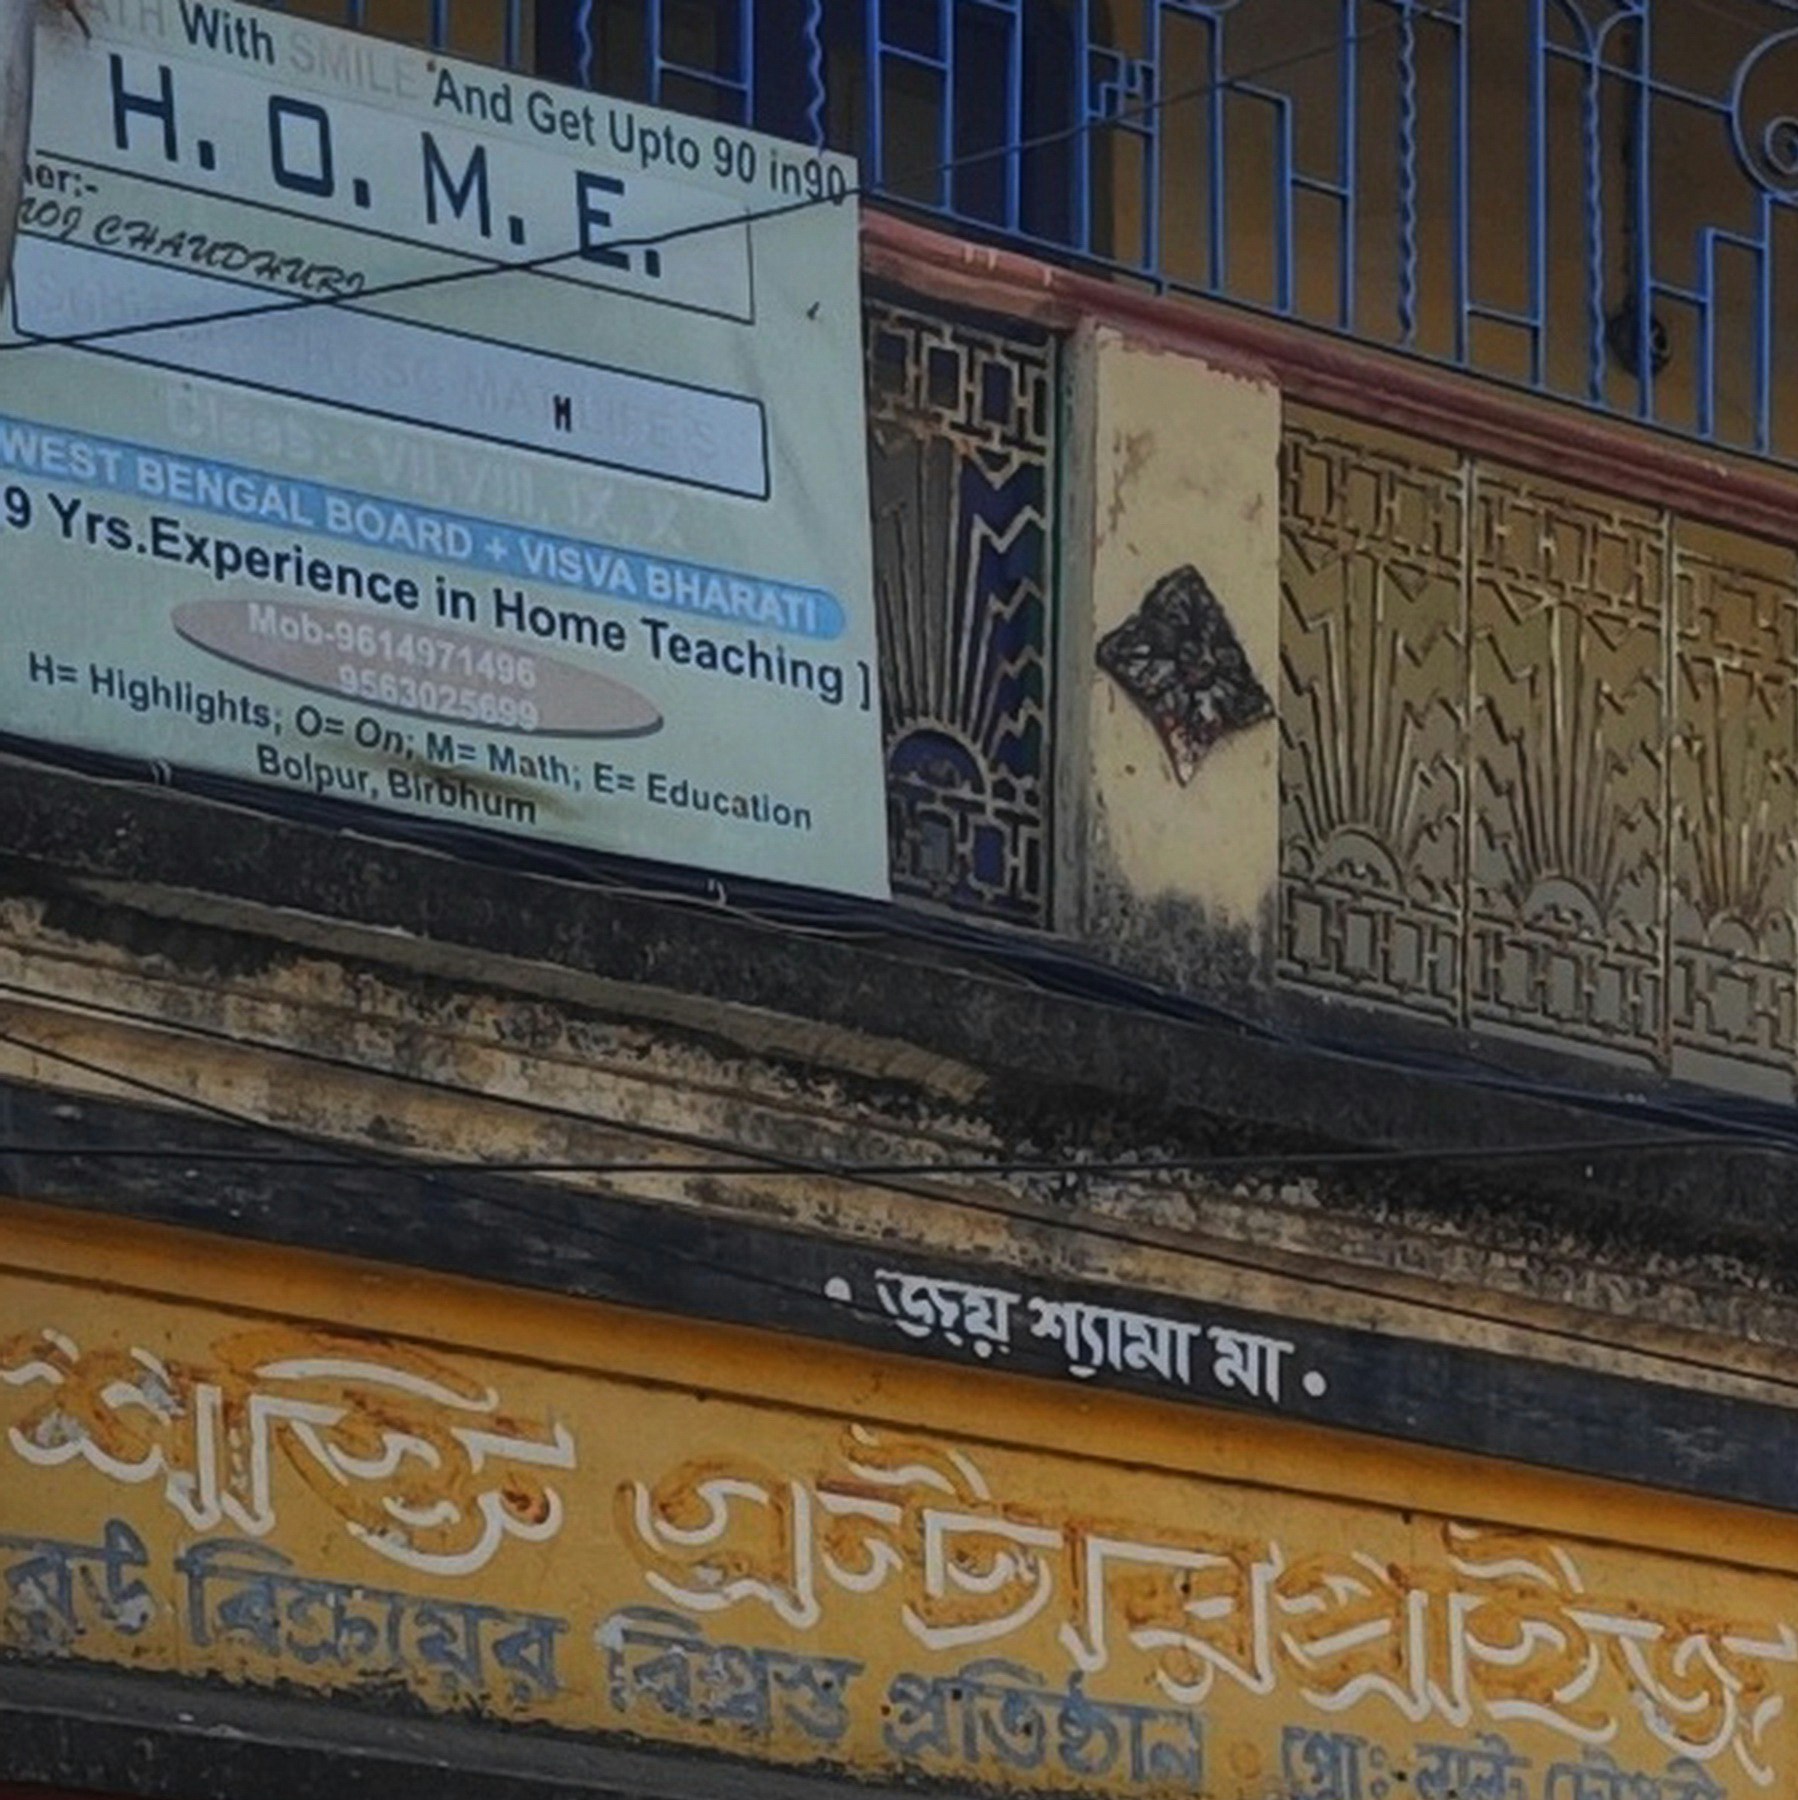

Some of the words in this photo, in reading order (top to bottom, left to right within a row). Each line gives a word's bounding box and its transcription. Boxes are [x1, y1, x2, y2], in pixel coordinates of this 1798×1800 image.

[179, 0, 275, 65] With
[433, 68, 513, 125] And
[528, 91, 596, 147] Get
[609, 111, 701, 169] Upto
[714, 136, 756, 183] 90
[2, 427, 122, 483] WEST
[136, 455, 314, 527] BENGAL
[326, 496, 474, 561] BOARD
[519, 536, 638, 596] VISVA
[647, 566, 817, 633] BHARATI
[436, 576, 476, 623] in
[494, 587, 627, 652] Home
[641, 618, 844, 704] Teaching
[256, 743, 380, 799] Bolpur,
[388, 767, 537, 826] Birbhum
[647, 773, 812, 830] Education
[874, 1268, 1021, 1359] জয়
[1028, 1297, 1200, 1386] শ্যামা
[1208, 1325, 1296, 1404] মা
